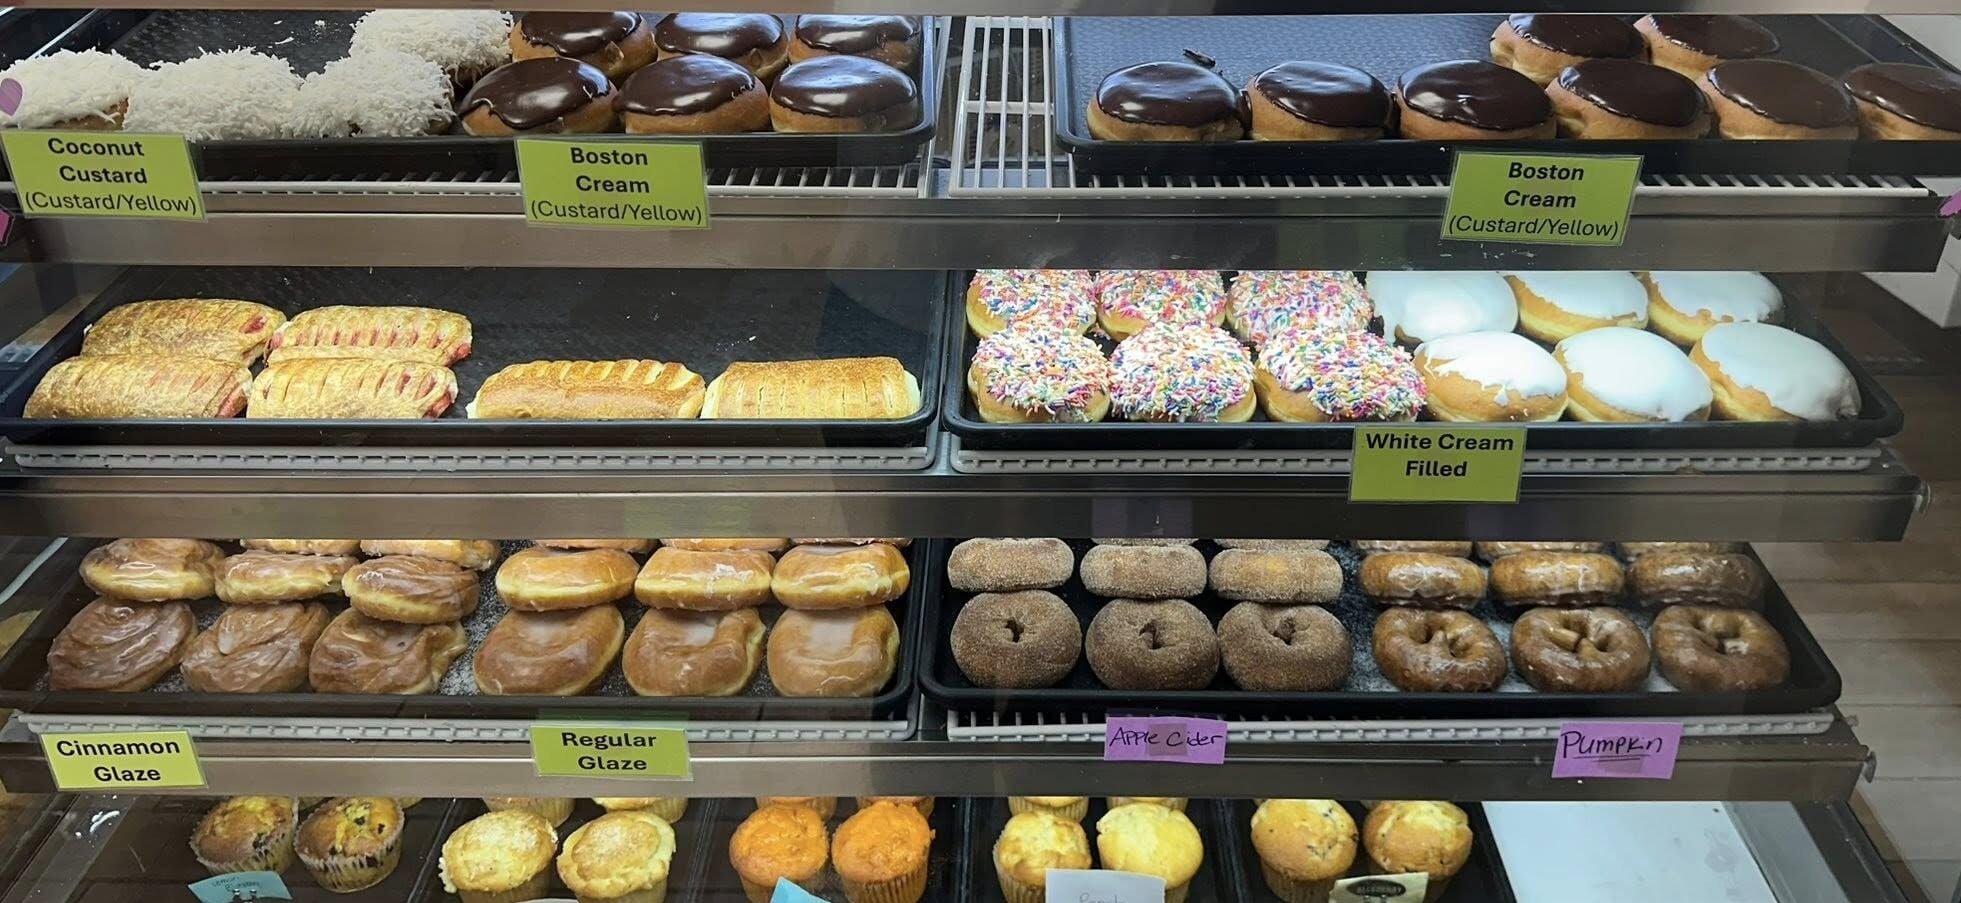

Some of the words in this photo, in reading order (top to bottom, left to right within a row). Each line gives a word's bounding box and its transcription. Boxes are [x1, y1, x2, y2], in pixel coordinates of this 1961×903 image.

[48, 138, 144, 156] Coconut
[570, 147, 648, 165] Boston
[59, 166, 148, 184] Custard
[1508, 162, 1584, 181] Boston
[576, 175, 650, 193] Cream
[25, 192, 197, 216] (Custard/Yellow)
[1504, 190, 1577, 208] Cream
[531, 200, 702, 225] (Custard/Yellow)
[1449, 215, 1619, 240] (Custard/Yellow)
[1366, 433, 1432, 449] White
[1438, 433, 1514, 450] Cream
[1405, 460, 1468, 477] Filled
[56, 740, 181, 756] Cinnamon
[561, 732, 657, 750] Regular
[1166, 732, 1223, 747] Cider
[578, 756, 647, 770] Glaze
[94, 766, 161, 781] Glaze
